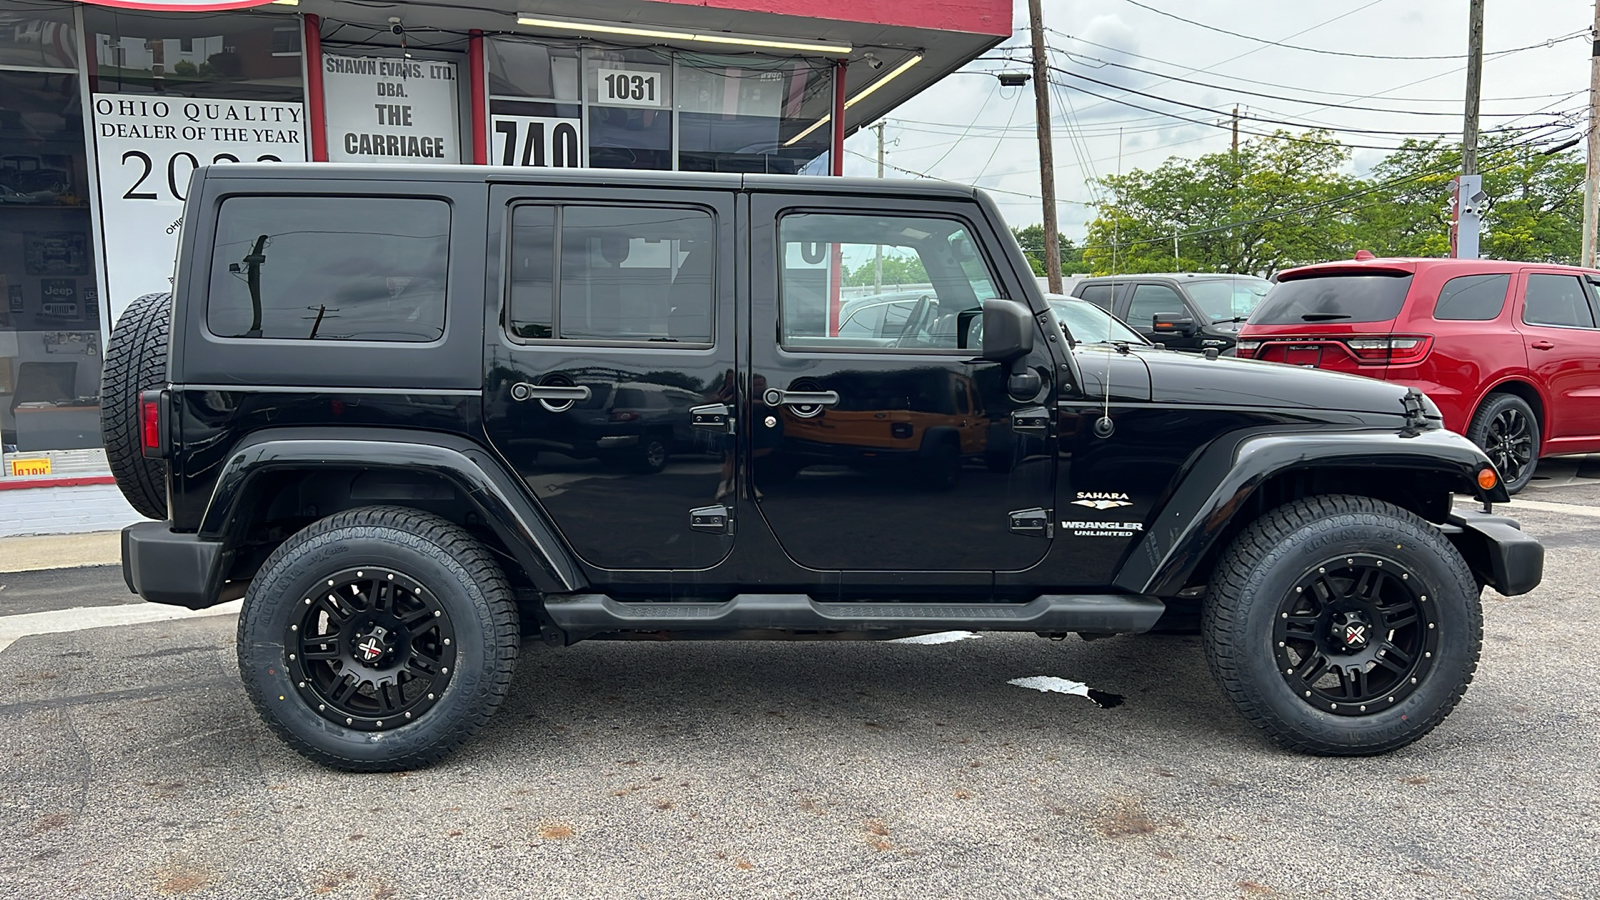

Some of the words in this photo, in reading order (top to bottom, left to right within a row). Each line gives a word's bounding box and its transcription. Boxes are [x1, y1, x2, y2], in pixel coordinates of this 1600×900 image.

[326, 58, 376, 75] SHAWN
[430, 65, 455, 80] LTD.
[377, 82, 408, 98] DBA.
[604, 73, 655, 101] 1031
[96, 98, 169, 118] OHIO
[184, 104, 301, 123] QUALITY
[375, 104, 413, 127] THE
[100, 122, 177, 140] DEALER
[182, 126, 206, 141] OF
[211, 127, 248, 142] THE
[252, 129, 300, 144] YEAR
[496, 121, 578, 167] 740
[344, 132, 445, 158] CARRIAGE
[121, 150, 283, 201] 20
[44, 286, 73, 297] Jeep
[1061, 521, 1145, 531] WRANGLER
